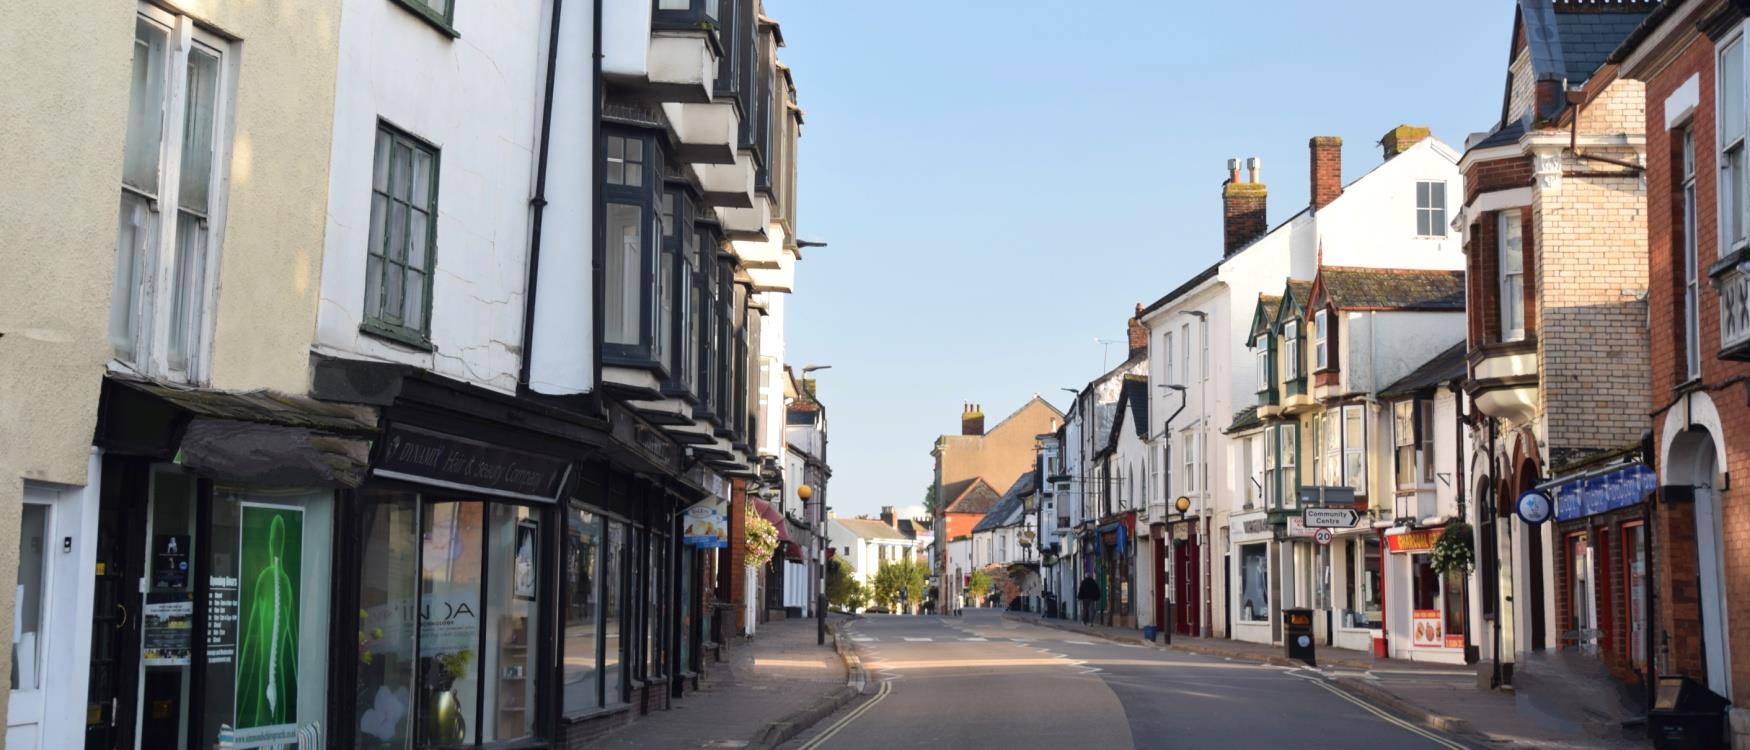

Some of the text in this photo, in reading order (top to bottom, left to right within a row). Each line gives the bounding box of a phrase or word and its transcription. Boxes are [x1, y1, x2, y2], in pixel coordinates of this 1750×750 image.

[442, 452, 467, 473] Hair
[464, 458, 475, 476] &
[504, 462, 544, 491] Company
[1308, 510, 1347, 518] Community
[1317, 533, 1329, 541] 20
